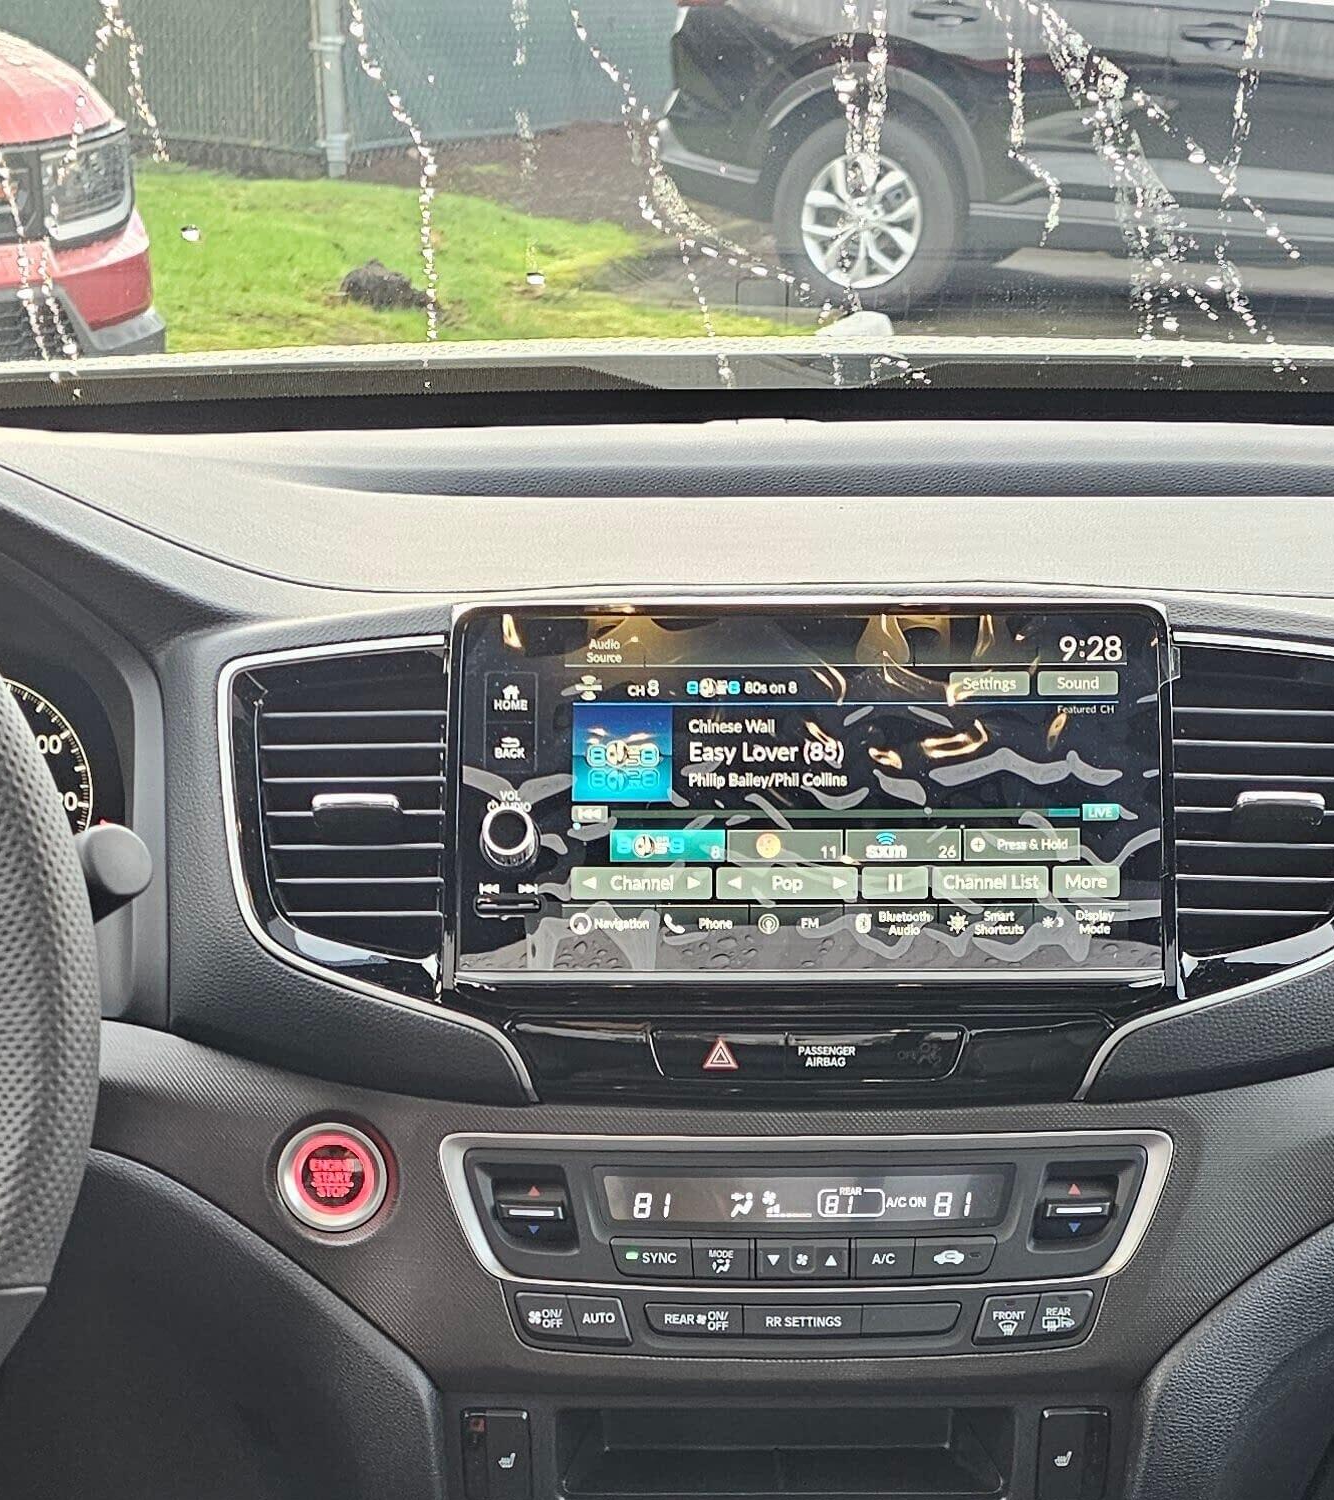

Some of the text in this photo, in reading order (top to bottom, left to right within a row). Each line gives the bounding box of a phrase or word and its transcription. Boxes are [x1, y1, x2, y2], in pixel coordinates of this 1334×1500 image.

[589, 638, 621, 650] Audio
[1059, 635, 1123, 662] 9:28
[586, 652, 622, 663] Source
[627, 680, 660, 697] CH 8
[744, 681, 768, 694] 80s
[770, 683, 786, 694] on
[788, 681, 798, 694] 8
[963, 677, 1017, 693] Settings
[1057, 677, 1100, 690] Sound
[493, 699, 528, 711] HOME
[1057, 705, 1115, 714] Featured CH
[688, 719, 775, 734] Chinese Wall
[494, 747, 525, 760] BACK
[689, 740, 845, 766] Easy Lover (85)
[688, 772, 848, 790] Philip Bailey/Phil Collins
[499, 790, 521, 801] VOL
[1088, 807, 1113, 819] LIVE
[997, 838, 1069, 851] Press & Hold
[821, 845, 837, 859] 11
[938, 846, 957, 859] 26
[610, 875, 674, 891] Channel
[772, 875, 804, 894] Pop
[943, 875, 1040, 891] Channel List
[1065, 875, 1108, 890] More
[878, 911, 932, 923] Bluetooth
[983, 911, 1016, 923] Smart
[1076, 910, 1115, 925] Display
[594, 918, 650, 931] Navigation
[698, 918, 733, 929] Phone
[801, 918, 819, 929] FM
[974, 923, 1026, 936] Shortcuts
[1079, 923, 1111, 935] Mode
[888, 924, 921, 936] Audio
[798, 1046, 855, 1057] PASSENGER
[805, 1057, 846, 1067] AIRBAG
[839, 1186, 862, 1196] REAR
[633, 1192, 671, 1219] 81
[824, 1195, 854, 1214] 81
[886, 1196, 927, 1208] A/C ON
[933, 1191, 972, 1217] 81
[642, 1252, 677, 1264] SYNC
[709, 1249, 734, 1260] MODE
[872, 1252, 895, 1265] A/C
[542, 1309, 562, 1319] ON/
[708, 1311, 729, 1322] ON/
[993, 1311, 1026, 1320] FRONT
[1046, 1307, 1071, 1316] REAR
[542, 1318, 563, 1328] OFF
[583, 1313, 615, 1324] AUTO
[665, 1314, 694, 1325] REAR
[765, 1316, 842, 1328] RR SETTINGS
[708, 1321, 729, 1331] OFF
